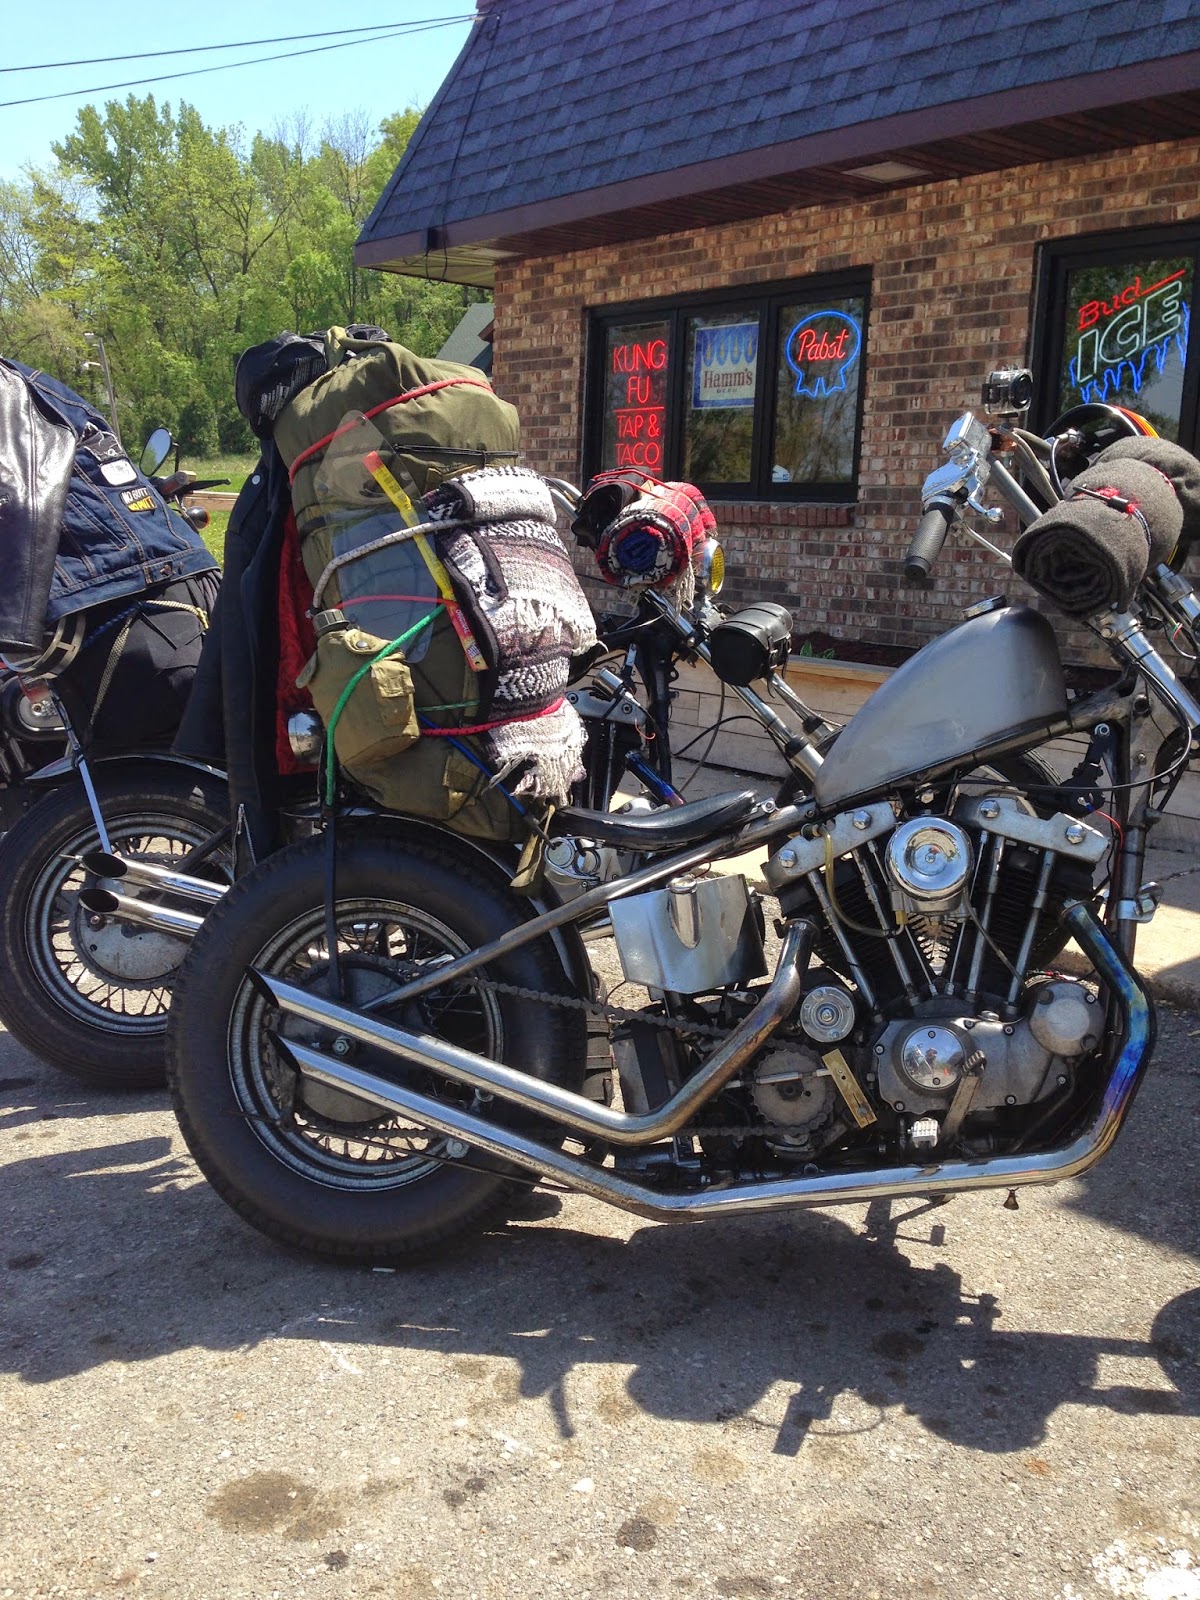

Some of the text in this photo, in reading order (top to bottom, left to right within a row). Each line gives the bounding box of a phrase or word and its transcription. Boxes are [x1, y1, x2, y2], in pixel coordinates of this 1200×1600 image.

[1078, 277, 1141, 330] Bud
[1077, 280, 1182, 383] ICE
[613, 340, 666, 373] KUNG
[798, 328, 849, 362] Pabst
[627, 376, 650, 404] FU
[704, 368, 753, 389] Hamm's
[617, 413, 660, 438] TAP &
[615, 442, 660, 465] TACO
[121, 491, 134, 504] NO
[128, 502, 140, 511] NO
